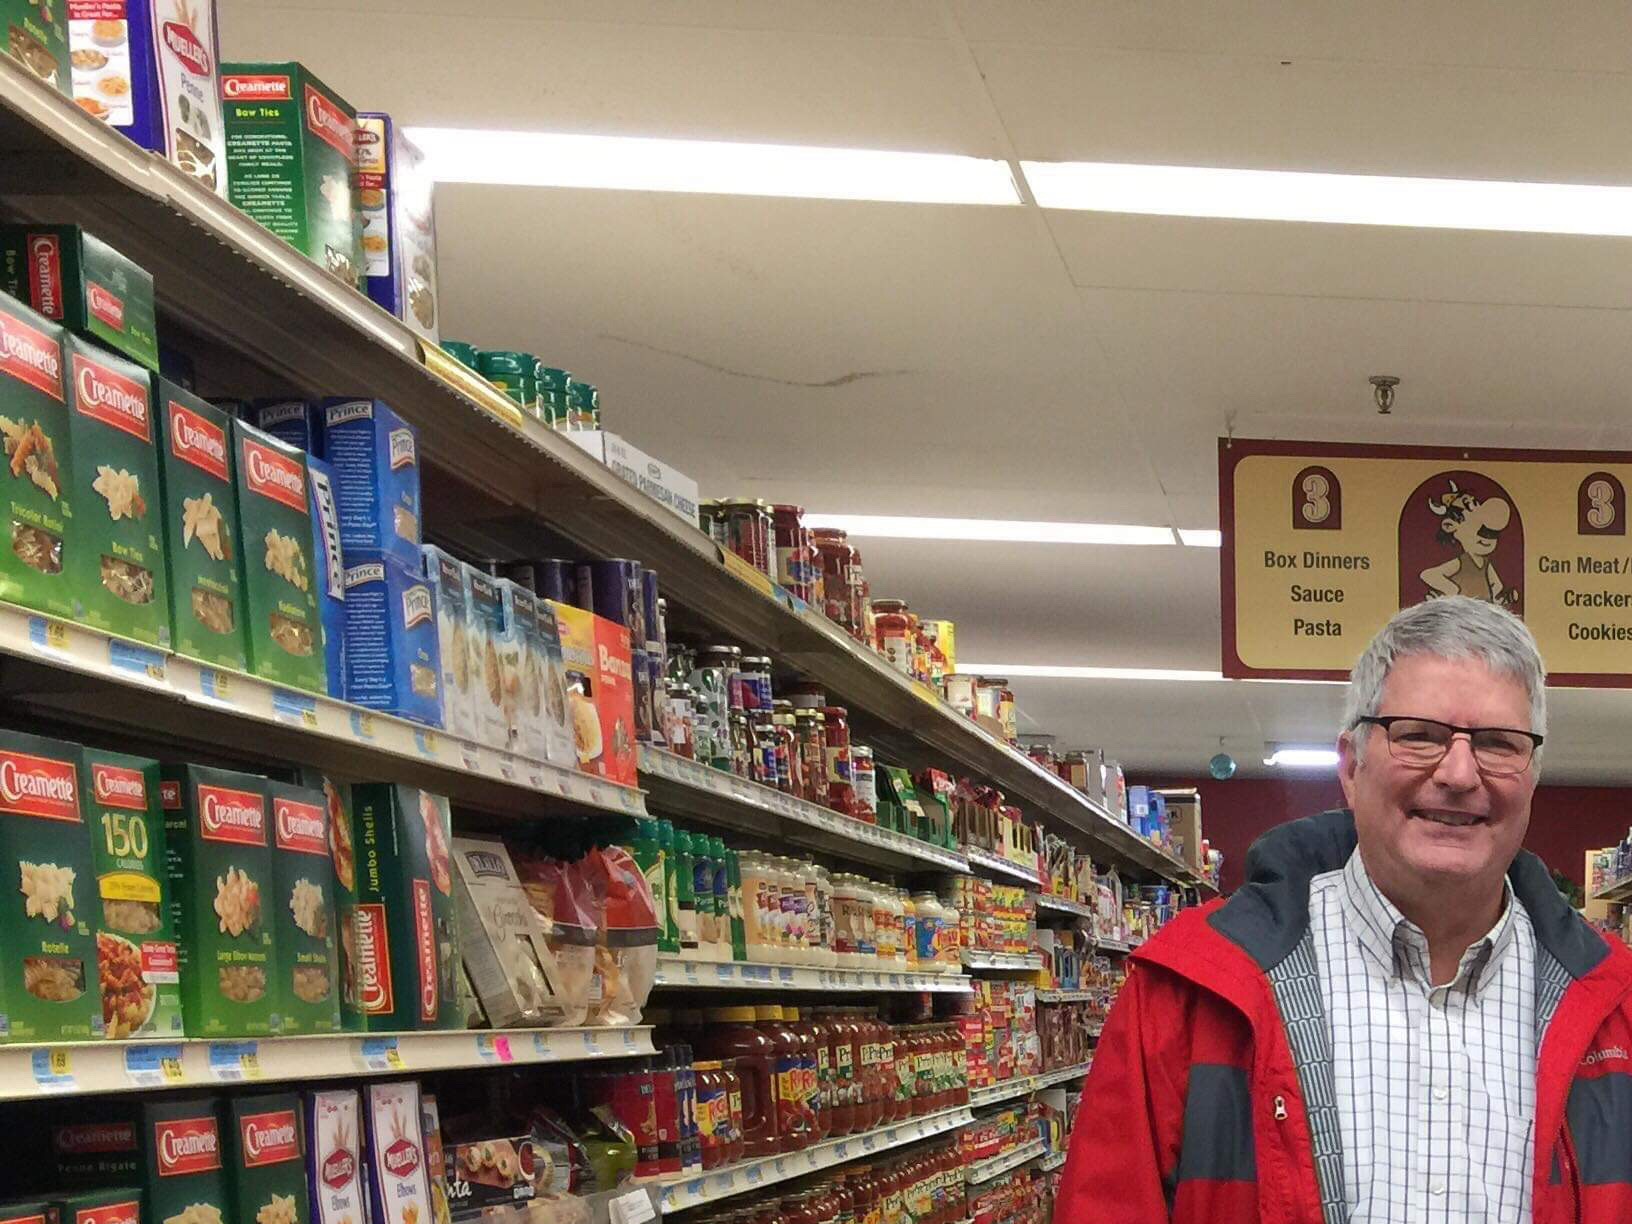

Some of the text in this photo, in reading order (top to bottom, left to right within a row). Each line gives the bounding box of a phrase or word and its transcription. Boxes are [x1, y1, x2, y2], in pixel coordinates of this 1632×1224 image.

[224, 79, 286, 96] Creamette
[236, 108, 280, 117] Bow Ties
[34, 239, 53, 316] Creamette
[78, 367, 146, 421] Creamette
[328, 404, 370, 421] Prince
[174, 412, 225, 459] Creamette
[249, 449, 304, 496] Creamette
[1302, 474, 1330, 523] 3
[1587, 480, 1614, 528] 3
[1264, 551, 1370, 571] Box Dinners
[1538, 556, 1571, 574] Can
[1290, 585, 1344, 603] Sauce
[1294, 619, 1342, 637] Pasta
[0, 761, 74, 801] Creamette
[97, 771, 144, 797] Creamette
[205, 795, 262, 831] Creamette
[279, 808, 325, 839] Creamette
[101, 813, 148, 857] 150
[365, 806, 380, 892] Jumbo Shells
[358, 909, 386, 1009] Creamette
[160, 1128, 216, 1164] Creamette
[246, 1124, 295, 1155] Creamette
